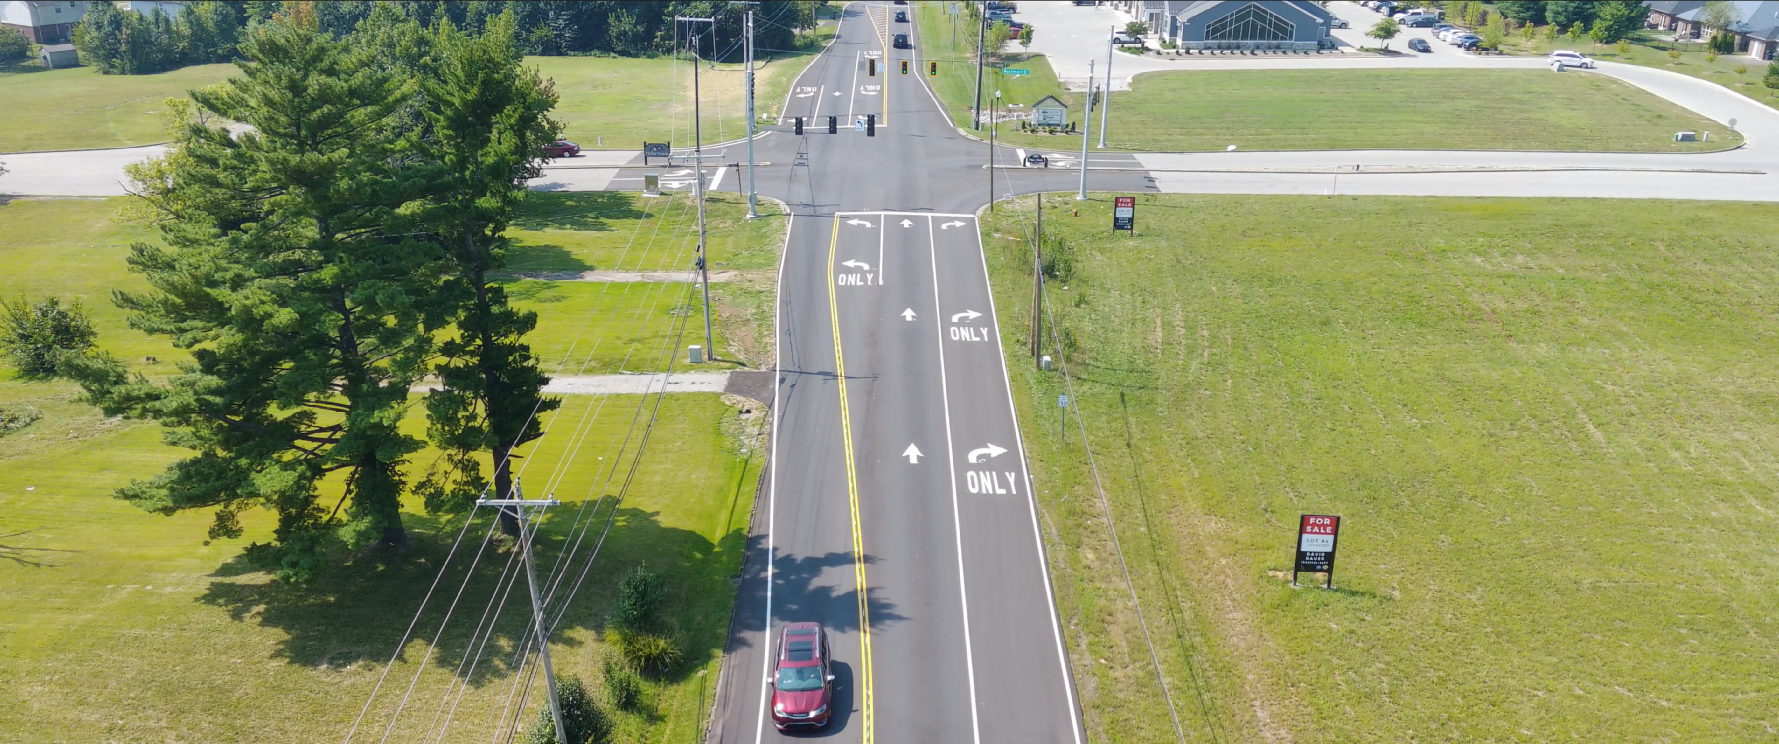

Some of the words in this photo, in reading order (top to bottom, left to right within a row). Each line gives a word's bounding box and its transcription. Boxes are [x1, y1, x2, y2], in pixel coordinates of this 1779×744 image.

[838, 273, 873, 286] ONLY
[950, 326, 989, 342] ONLY
[966, 471, 1017, 495] ONLY
[1309, 517, 1331, 525] FOR
[1305, 525, 1333, 533] SALE
